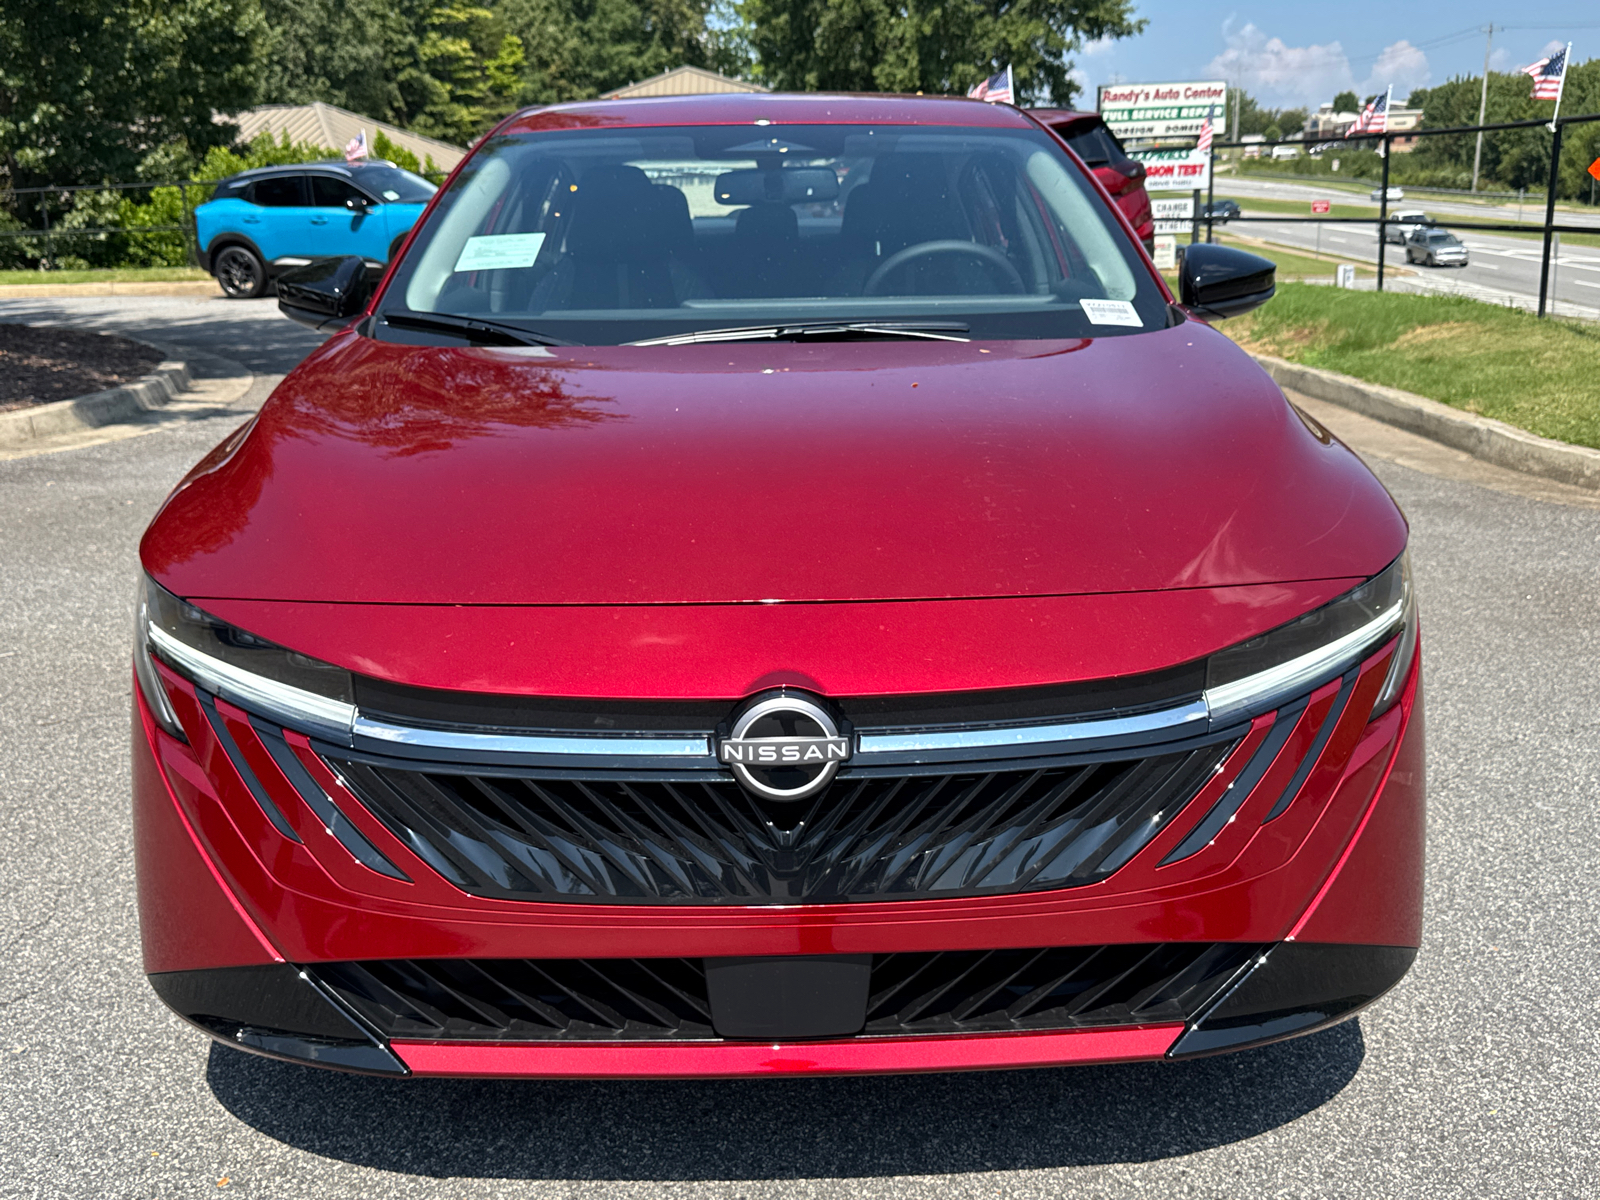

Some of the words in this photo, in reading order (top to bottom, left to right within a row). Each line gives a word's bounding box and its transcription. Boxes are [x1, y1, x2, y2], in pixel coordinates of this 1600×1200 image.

[1102, 89, 1150, 105] Randy's
[1153, 88, 1180, 100] Auto
[1184, 87, 1223, 99] Center
[1102, 110, 1129, 121] FULL
[1131, 108, 1178, 120] SERVICE
[1180, 107, 1223, 118] REPAR
[1178, 163, 1205, 176] TEST
[724, 742, 846, 761] NISSAN
